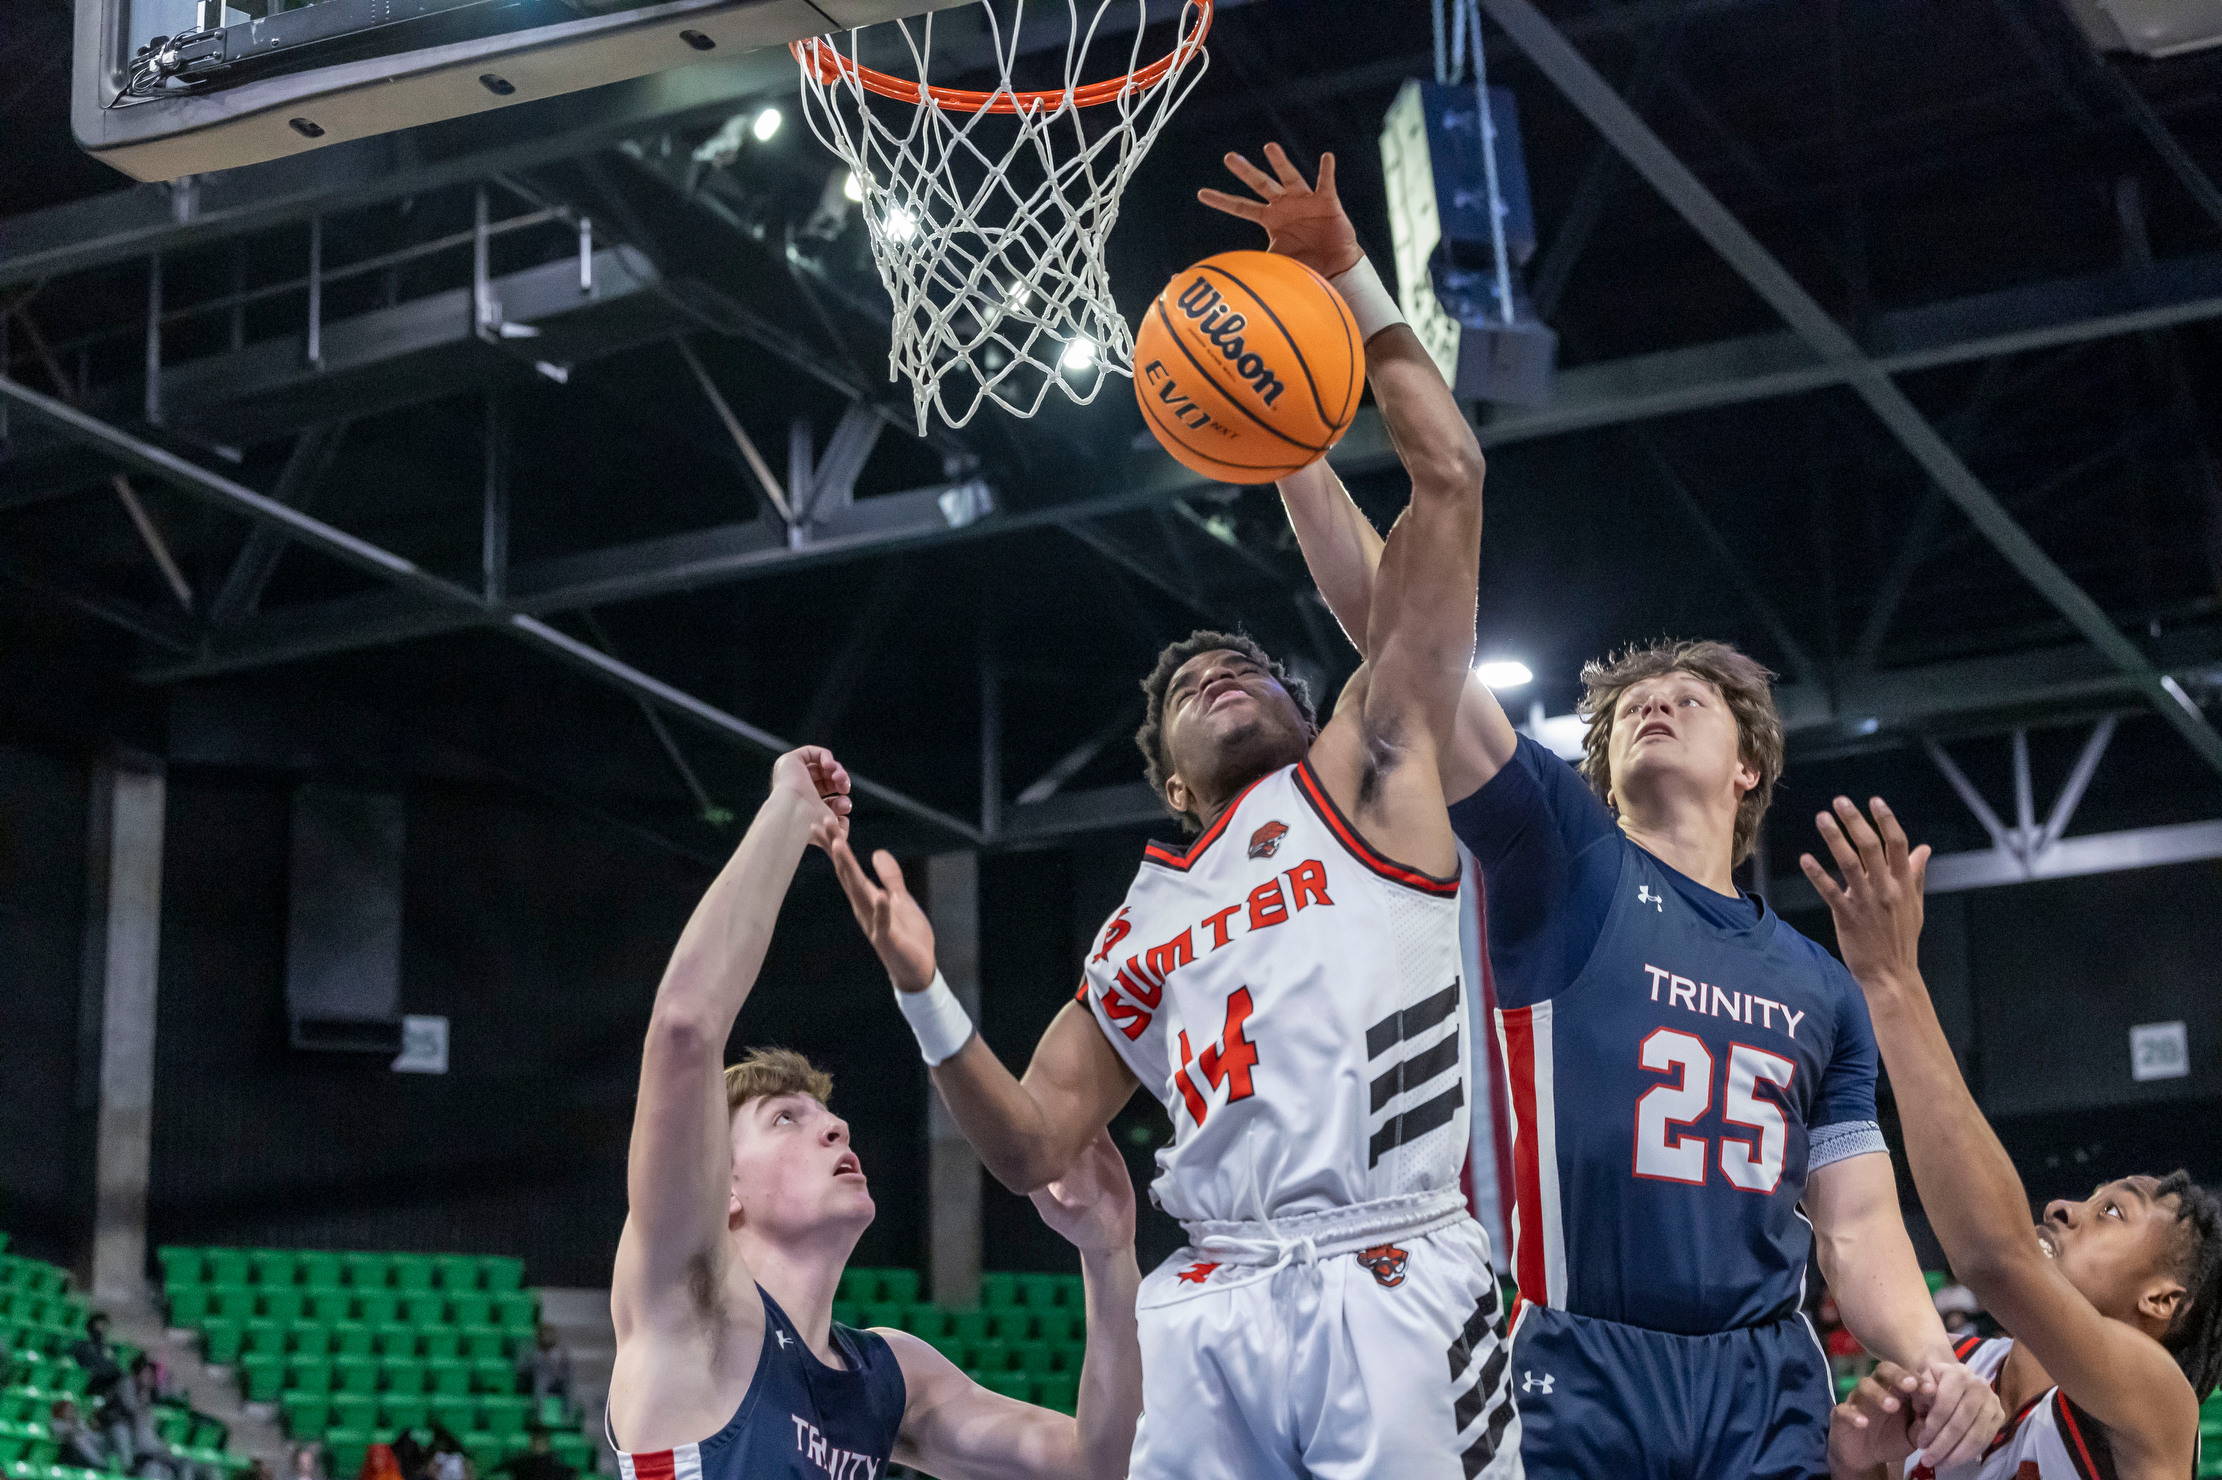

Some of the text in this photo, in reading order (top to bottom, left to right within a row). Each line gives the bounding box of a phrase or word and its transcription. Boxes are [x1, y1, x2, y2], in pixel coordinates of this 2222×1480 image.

[1177, 276, 1285, 407] Wilson
[1100, 858, 1335, 1042] SUMTER
[1644, 963, 1806, 1039] TRINITY
[1174, 985, 1259, 1129] 14
[1632, 1026, 1797, 1196] 25
